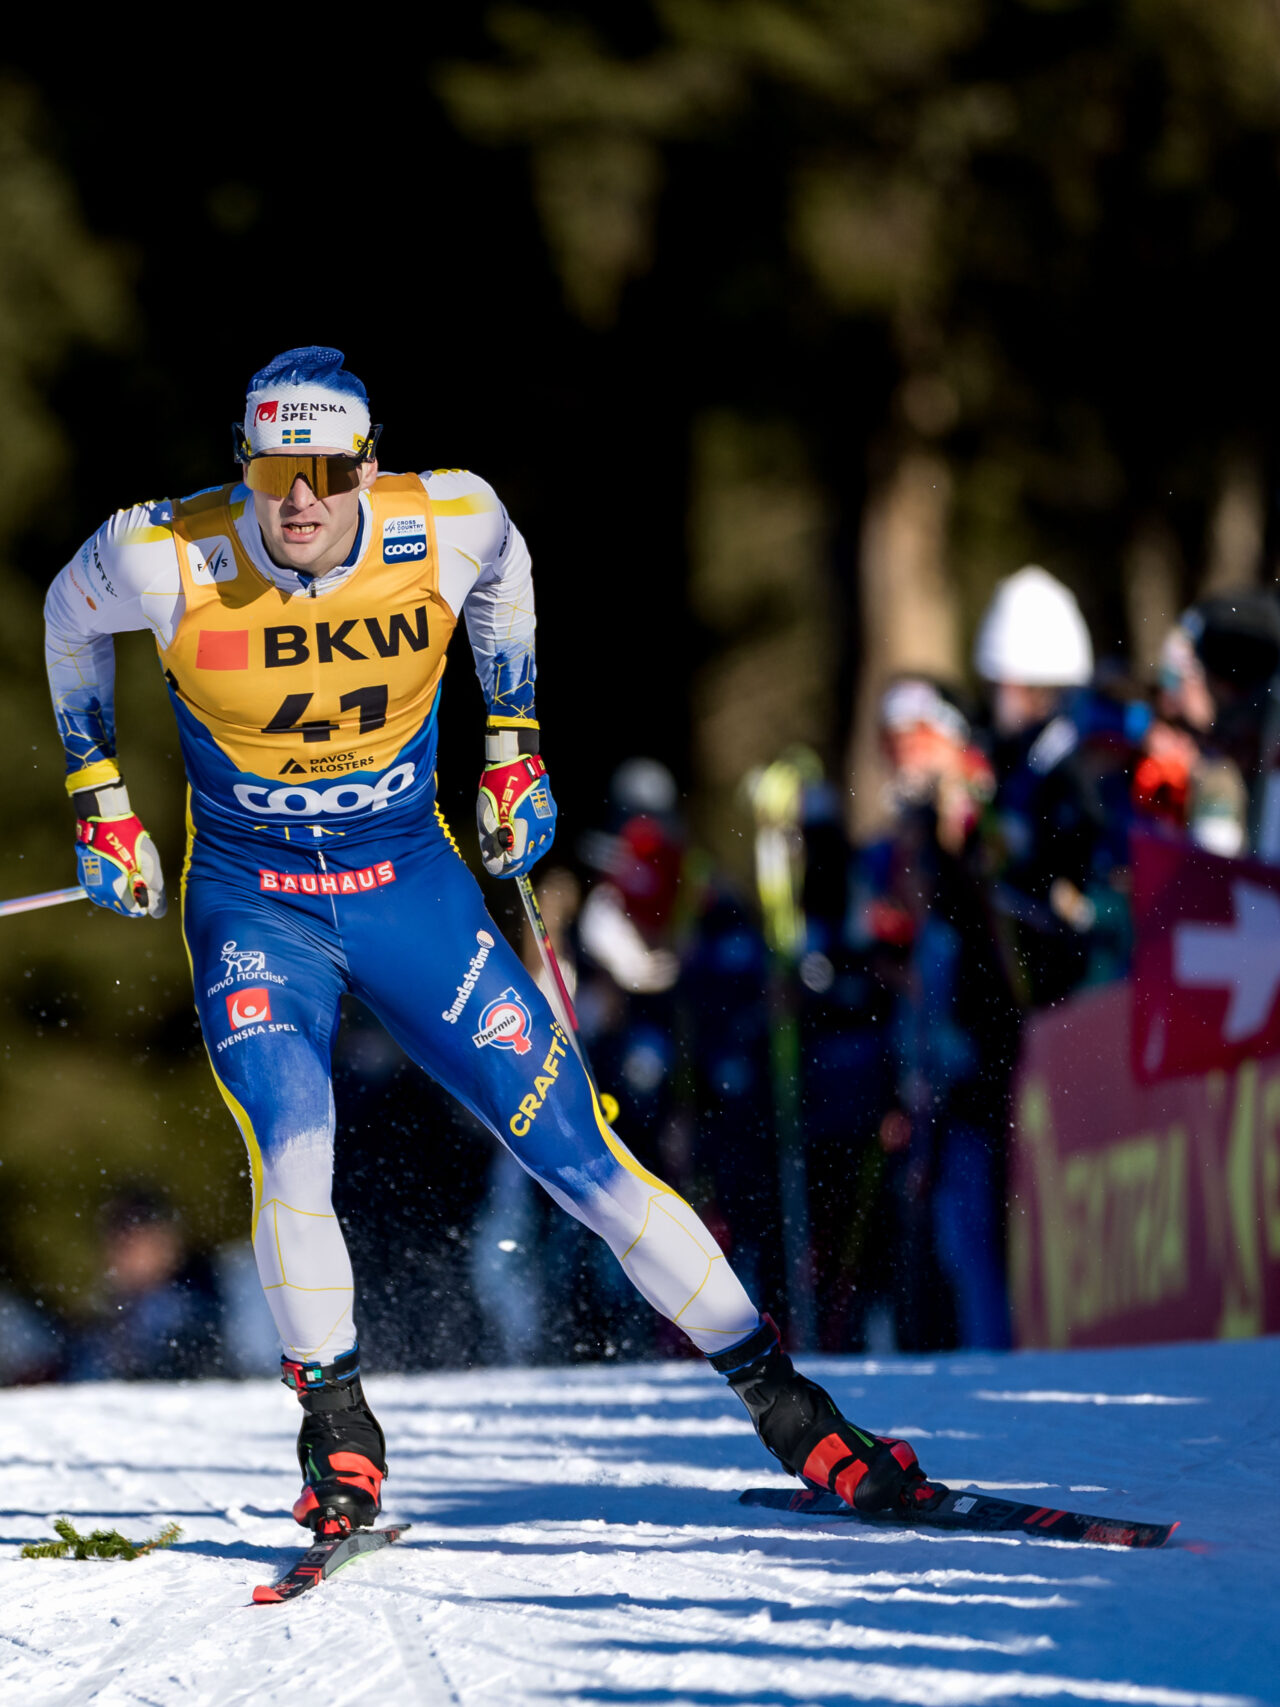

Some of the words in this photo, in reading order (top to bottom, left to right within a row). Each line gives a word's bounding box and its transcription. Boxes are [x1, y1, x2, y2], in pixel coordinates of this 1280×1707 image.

[281, 403, 347, 414] SVENSKA
[281, 412, 318, 422] SPEL
[384, 541, 426, 556] coop
[264, 606, 430, 668] BKW
[261, 684, 388, 743] 41
[310, 752, 356, 764] DAVOS
[310, 756, 375, 773] KLOSTERS
[233, 762, 415, 816] coop
[500, 775, 519, 819] LEKI
[105, 832, 137, 873] LEKI
[263, 864, 394, 893] BAUHAUS
[207, 976, 234, 998] novo
[236, 970, 285, 986] nordisk
[441, 946, 491, 1025] Sundström
[216, 1025, 266, 1053] SVENSKA
[268, 1023, 298, 1033] SPEL
[473, 1013, 517, 1046] Thermia
[509, 1036, 567, 1137] CRAFT
